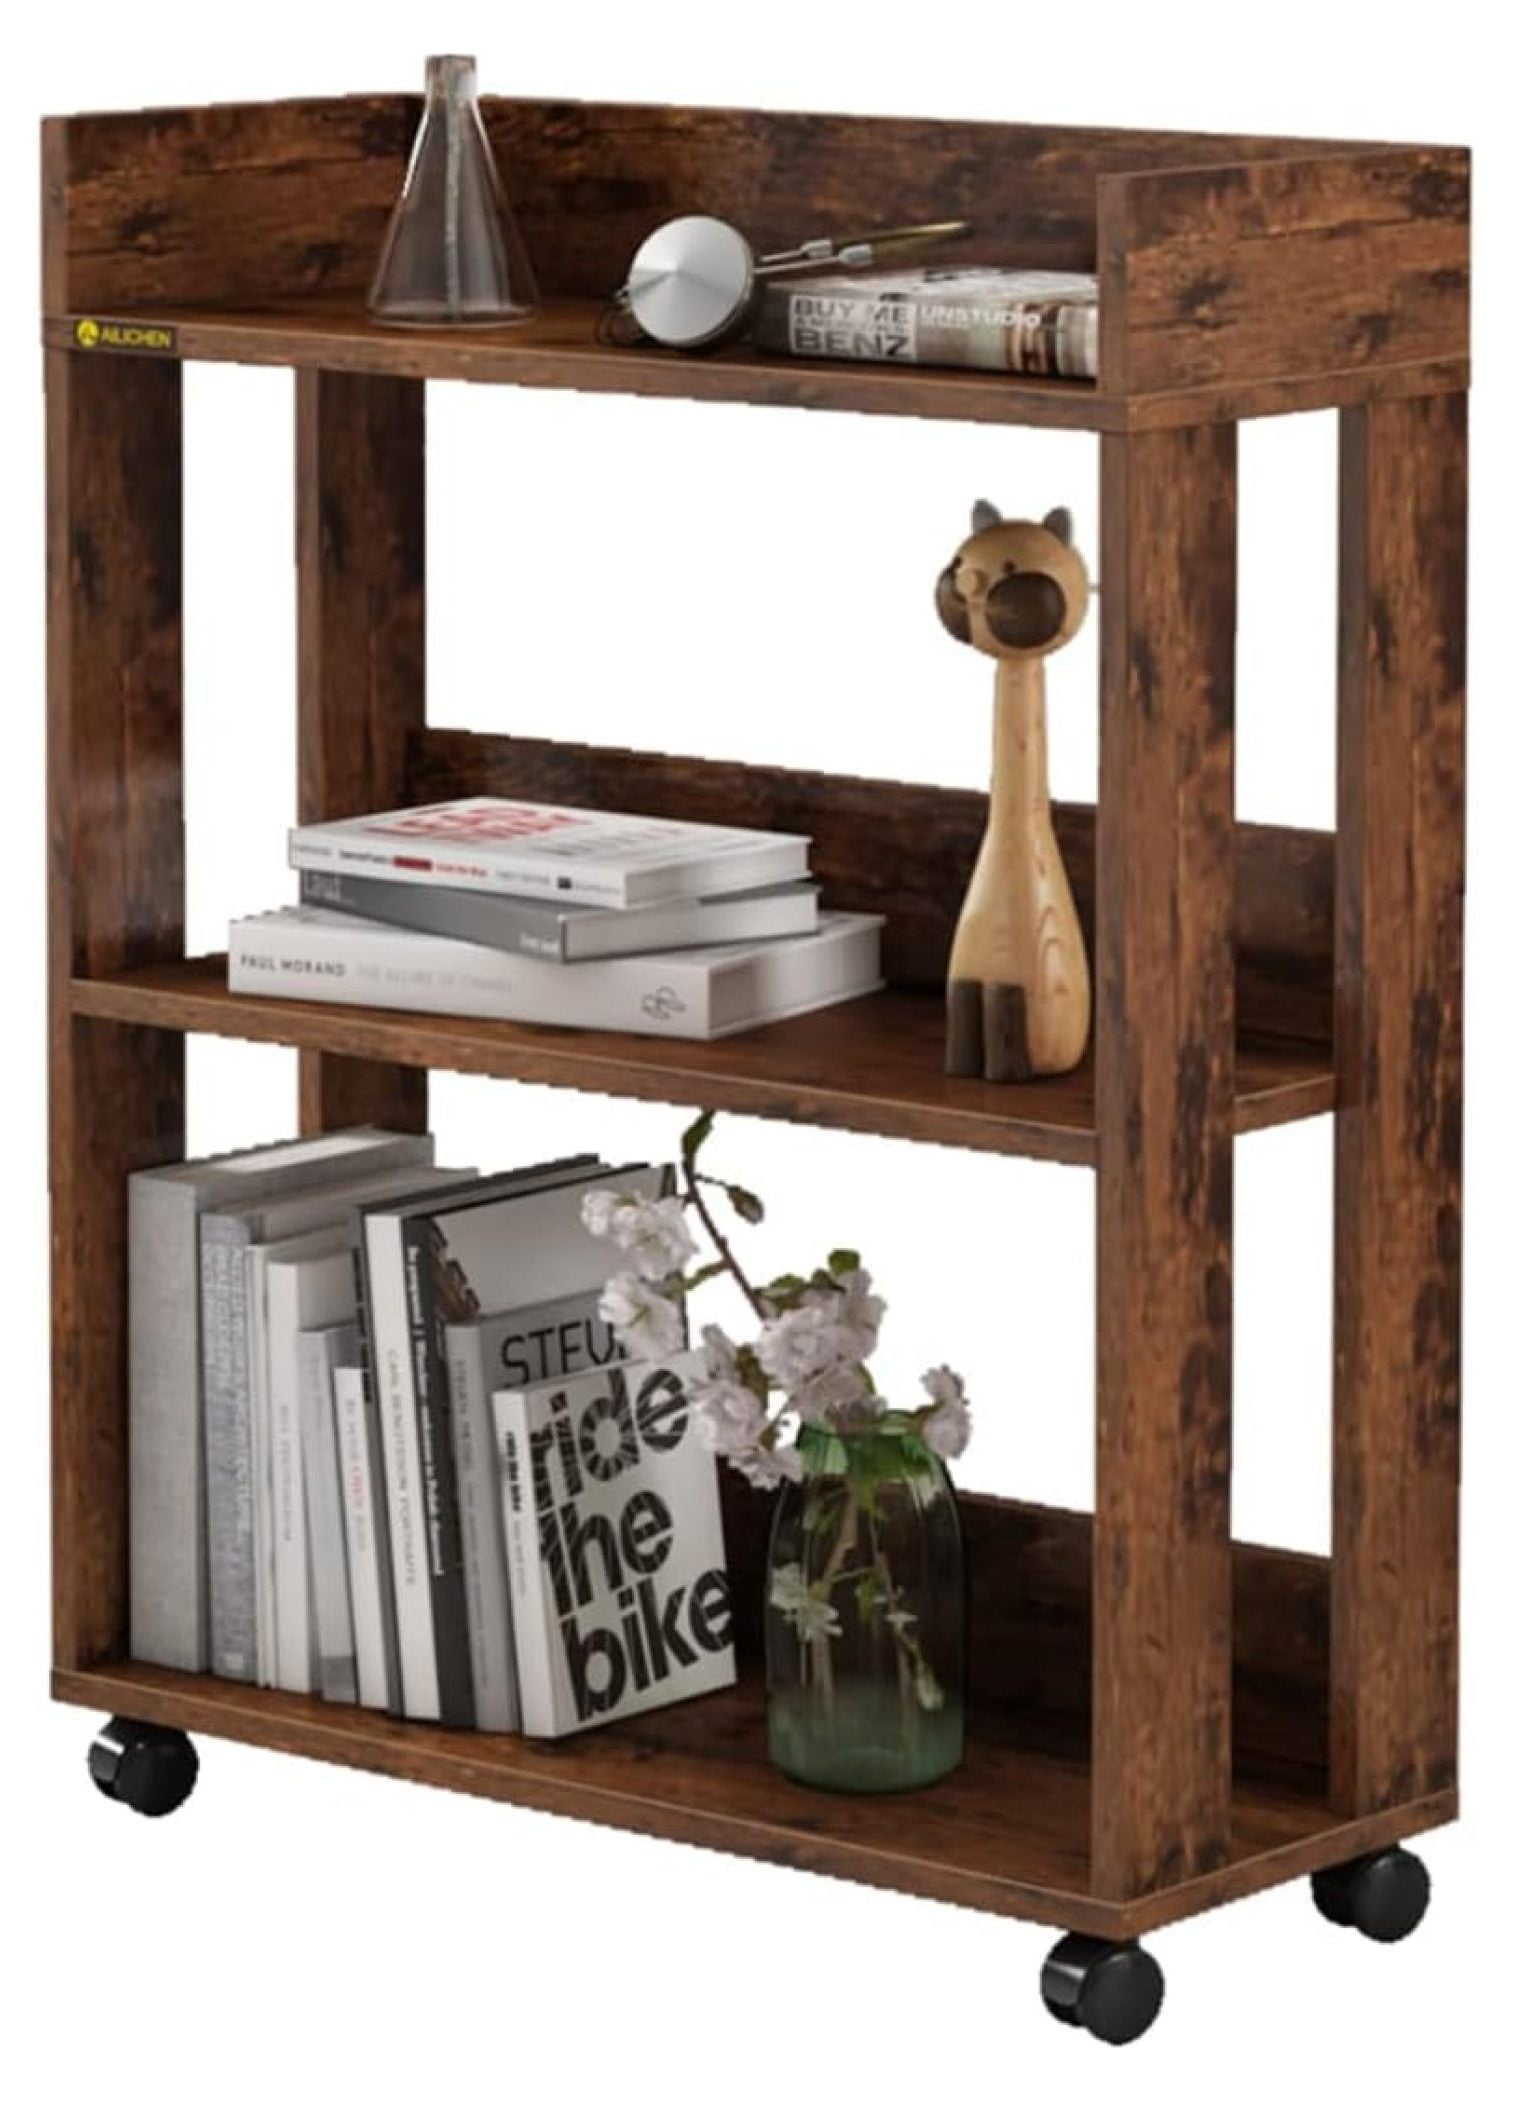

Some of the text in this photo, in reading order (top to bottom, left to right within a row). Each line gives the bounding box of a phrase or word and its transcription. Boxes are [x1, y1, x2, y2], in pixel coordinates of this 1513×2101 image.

[795, 298, 909, 323] BUY ME
[795, 327, 910, 357] BENZ
[239, 953, 347, 978] PAUL MORAND
[529, 1366, 689, 1513] ride
[538, 1490, 674, 1617] the
[560, 1568, 738, 1722] bike
